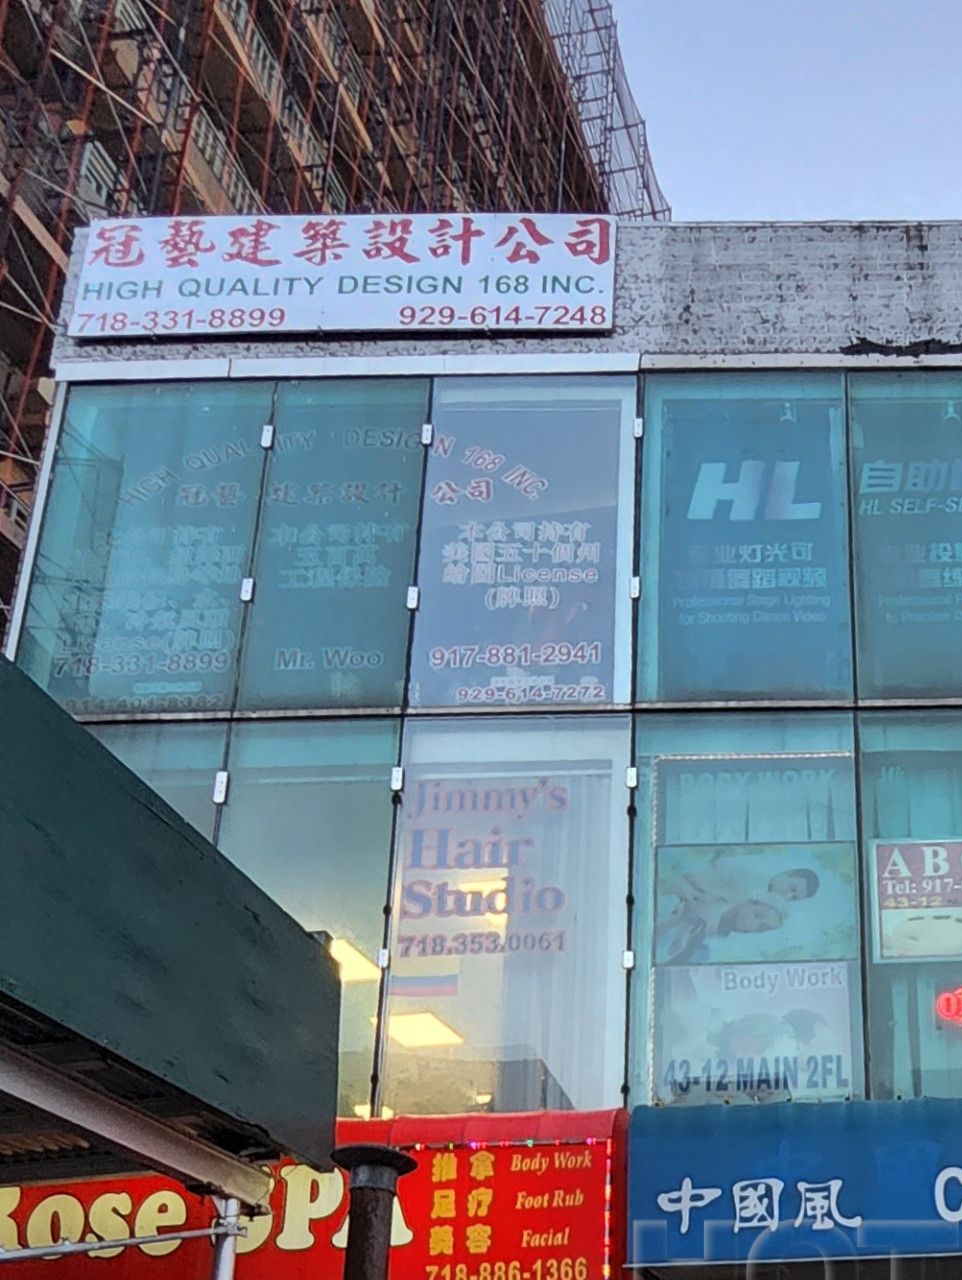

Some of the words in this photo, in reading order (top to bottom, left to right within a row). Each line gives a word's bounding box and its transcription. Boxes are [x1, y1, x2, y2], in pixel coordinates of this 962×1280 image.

[88, 217, 611, 269] 冠藝建築設計公司
[82, 279, 163, 301] HIGH
[177, 276, 323, 299] QUALITY
[338, 275, 463, 296] DESIGN
[479, 275, 530, 294] 168
[542, 275, 605, 294] INC.
[77, 307, 287, 333] 718-331-8899
[399, 305, 607, 327] 929-614-7248
[463, 446, 504, 472] 168
[687, 460, 822, 521] HL
[858, 498, 884, 516] HL
[54, 652, 232, 678] 718-331-8899
[321, 646, 383, 669] Woo
[430, 642, 603, 668] 917-881-2941
[405, 826, 536, 870] Hair
[401, 874, 567, 919] Studio
[881, 878, 918, 896] Tel:
[398, 930, 567, 958] 718.353.0061
[722, 968, 778, 993] Body
[786, 966, 844, 988] Work
[663, 1058, 731, 1093] 43-12
[735, 1056, 799, 1092] MAIN
[805, 1054, 850, 1089] 2FL
[510, 1153, 549, 1175] Body
[553, 1150, 593, 1169] Work
[515, 1191, 549, 1210] Foot
[552, 1189, 585, 1208] Rub
[656, 1175, 863, 1235] 中國風
[521, 1227, 570, 1248] Facial
